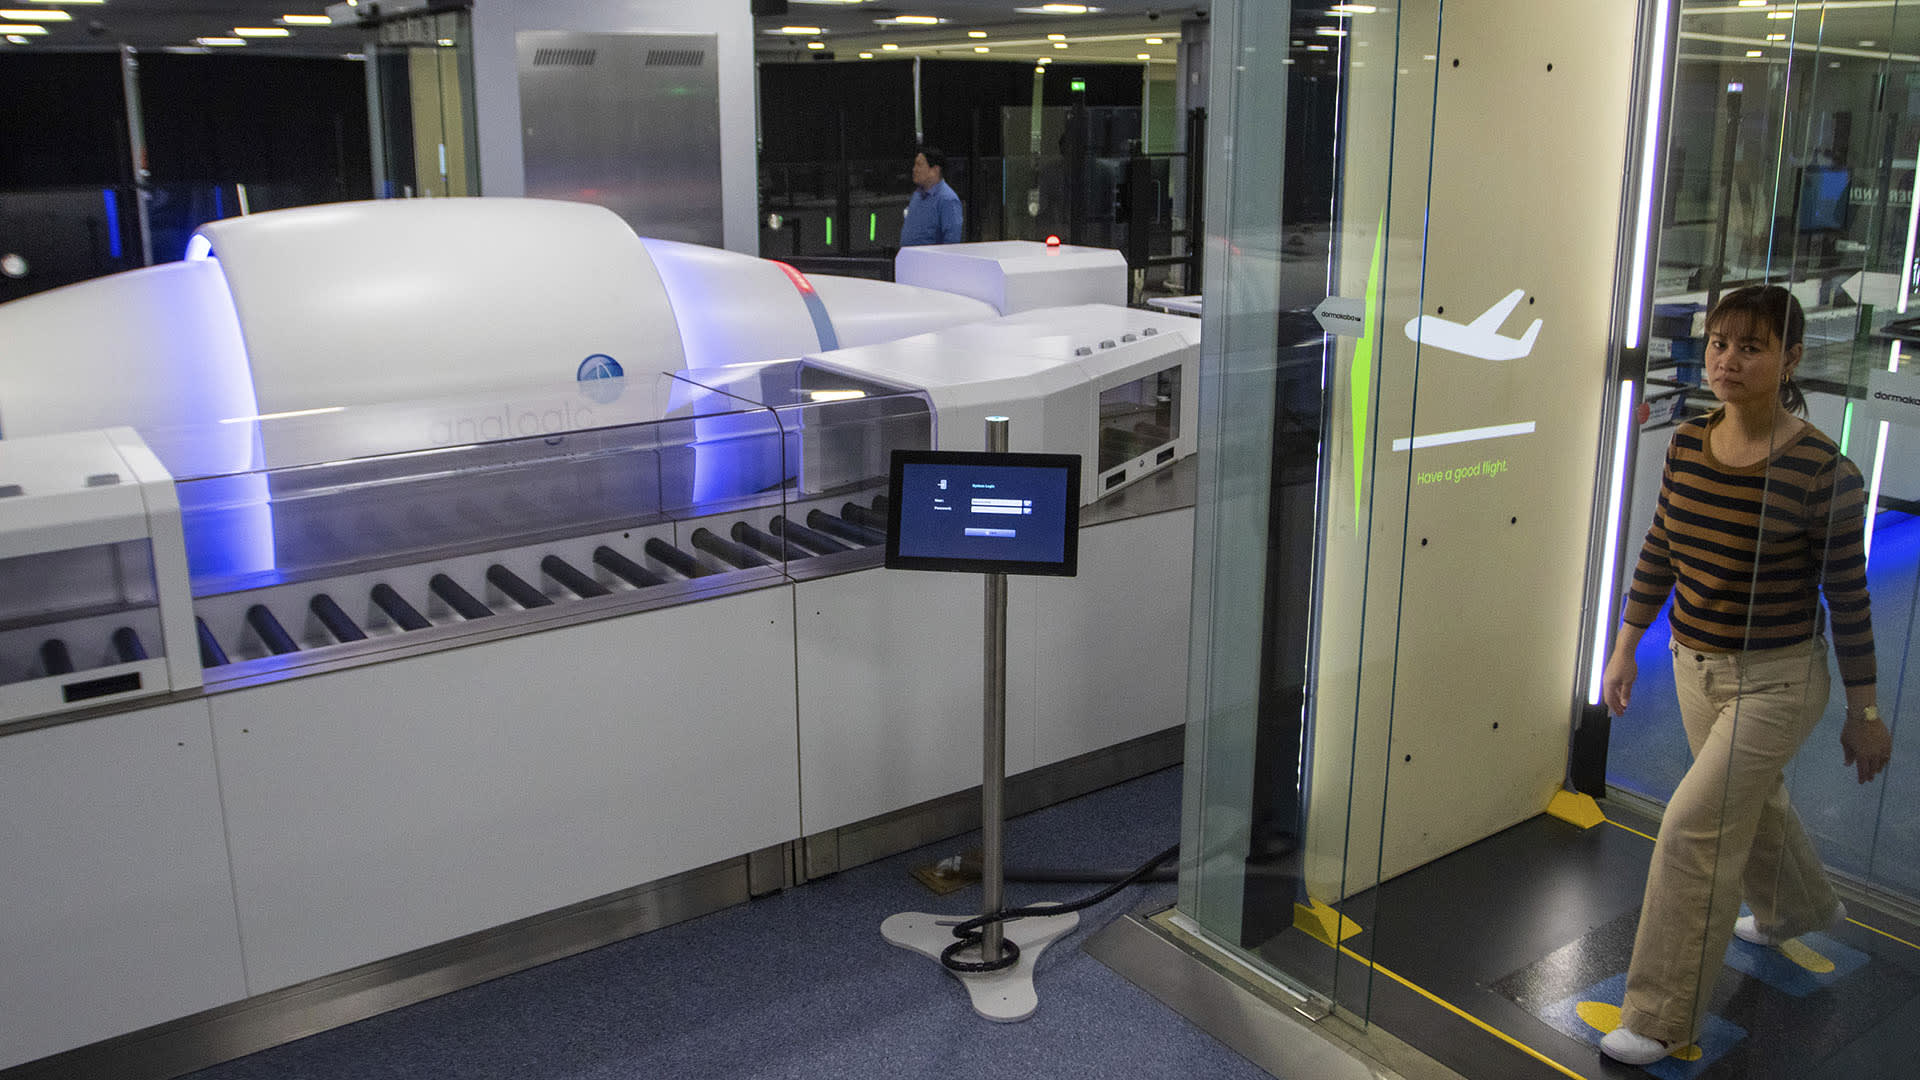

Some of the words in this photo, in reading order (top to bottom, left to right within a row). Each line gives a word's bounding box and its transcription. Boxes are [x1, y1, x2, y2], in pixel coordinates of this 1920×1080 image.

[430, 401, 594, 446] analogic
[1417, 471, 1443, 485] Have
[1445, 470, 1453, 481] a
[1454, 463, 1480, 484] good
